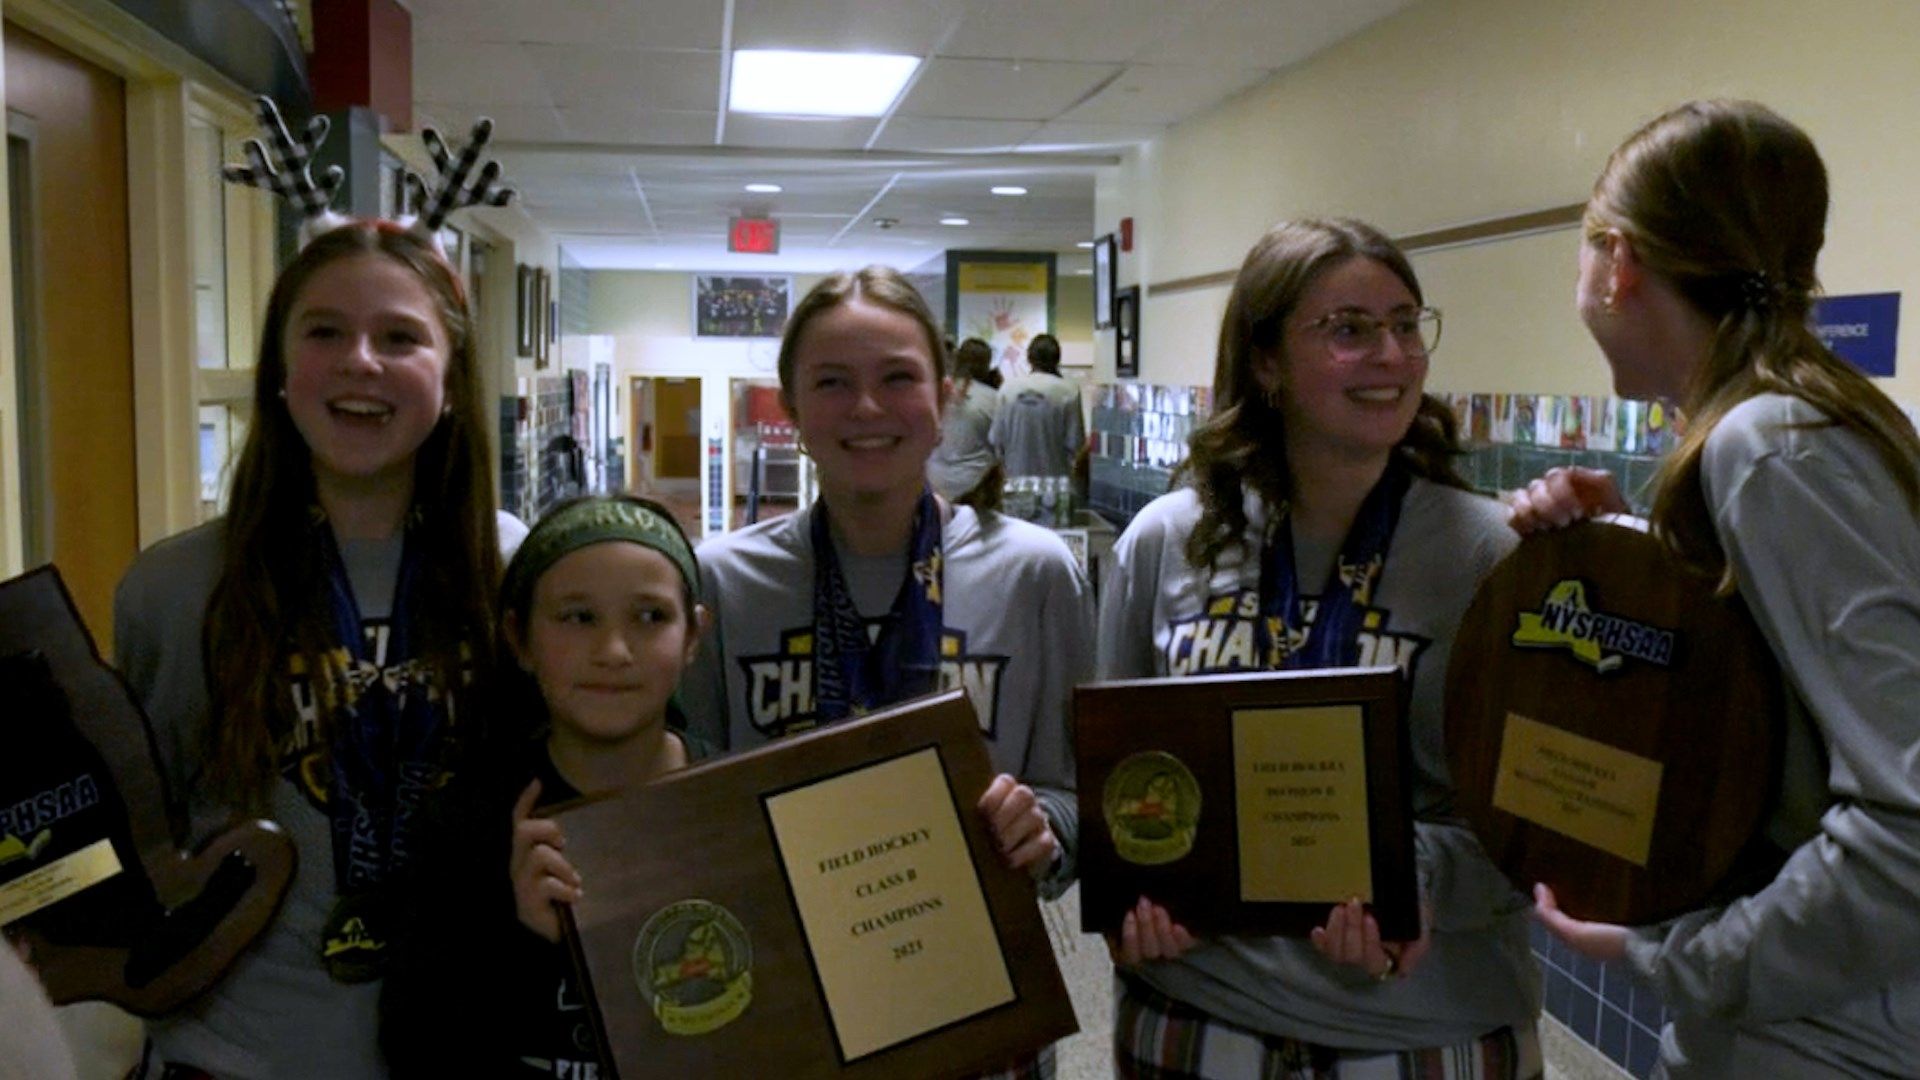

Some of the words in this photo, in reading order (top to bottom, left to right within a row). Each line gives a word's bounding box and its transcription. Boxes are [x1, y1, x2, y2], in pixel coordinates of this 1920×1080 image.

[1540, 600, 1675, 666] NYSPHSAA
[818, 848, 865, 874] FIELD
[867, 828, 931, 858] HOCKEY
[855, 873, 905, 898] CLASS
[850, 898, 943, 936] CHAMPIONS
